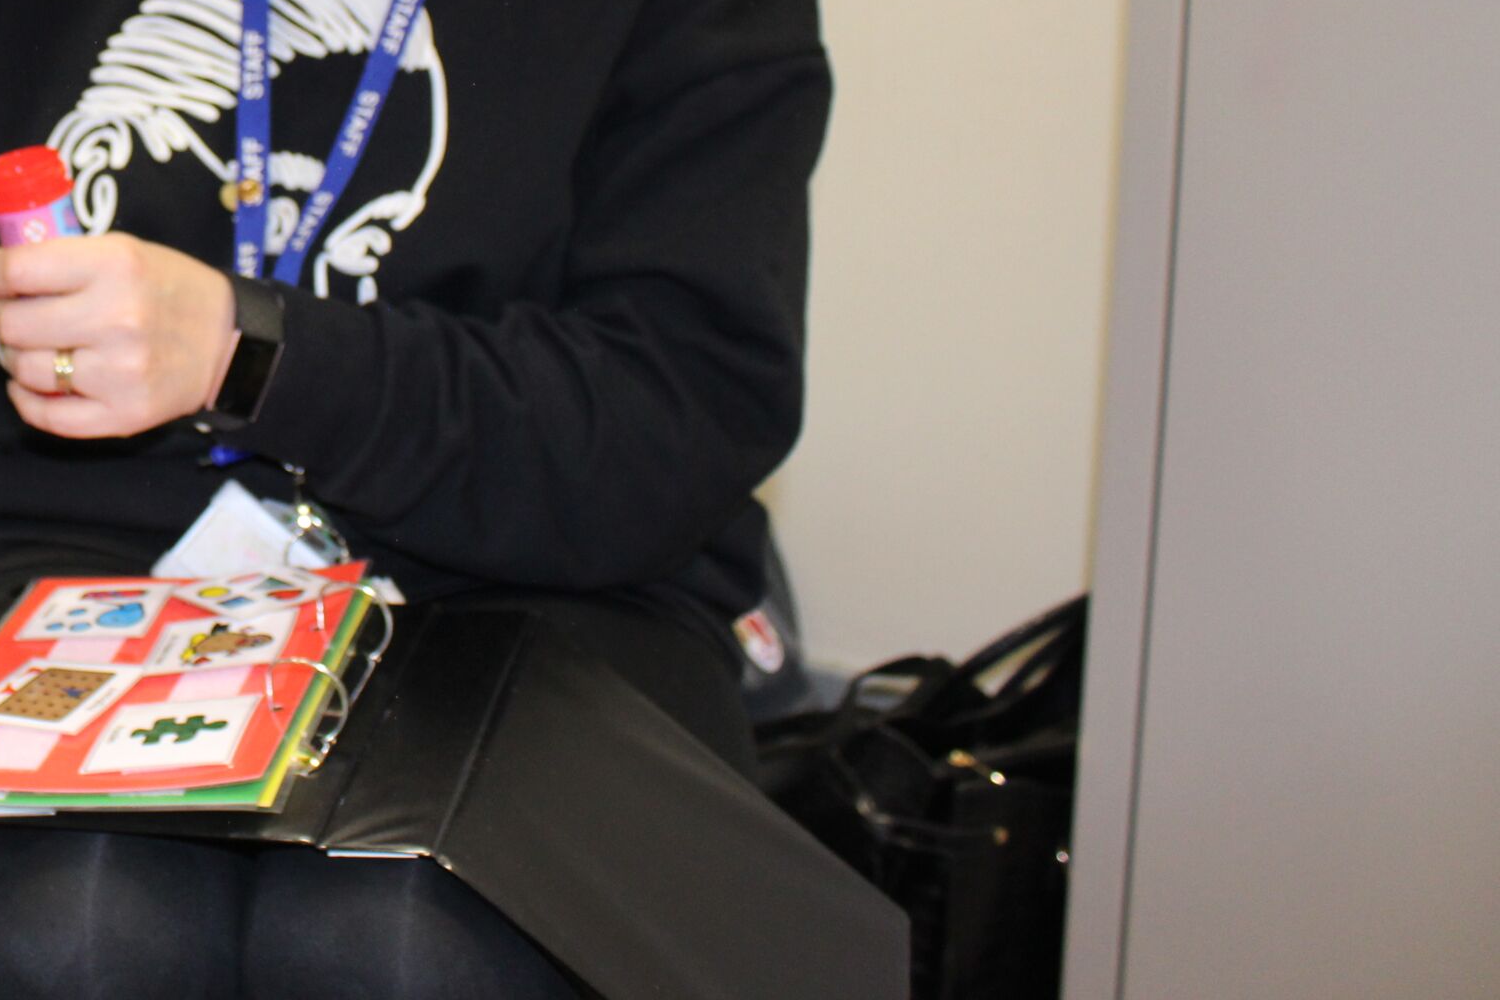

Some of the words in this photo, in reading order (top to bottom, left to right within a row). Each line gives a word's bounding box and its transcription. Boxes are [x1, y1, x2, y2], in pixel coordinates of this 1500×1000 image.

[241, 30, 265, 100] STAFF
[339, 90, 380, 158] STAFF
[291, 190, 334, 253] STAFF
